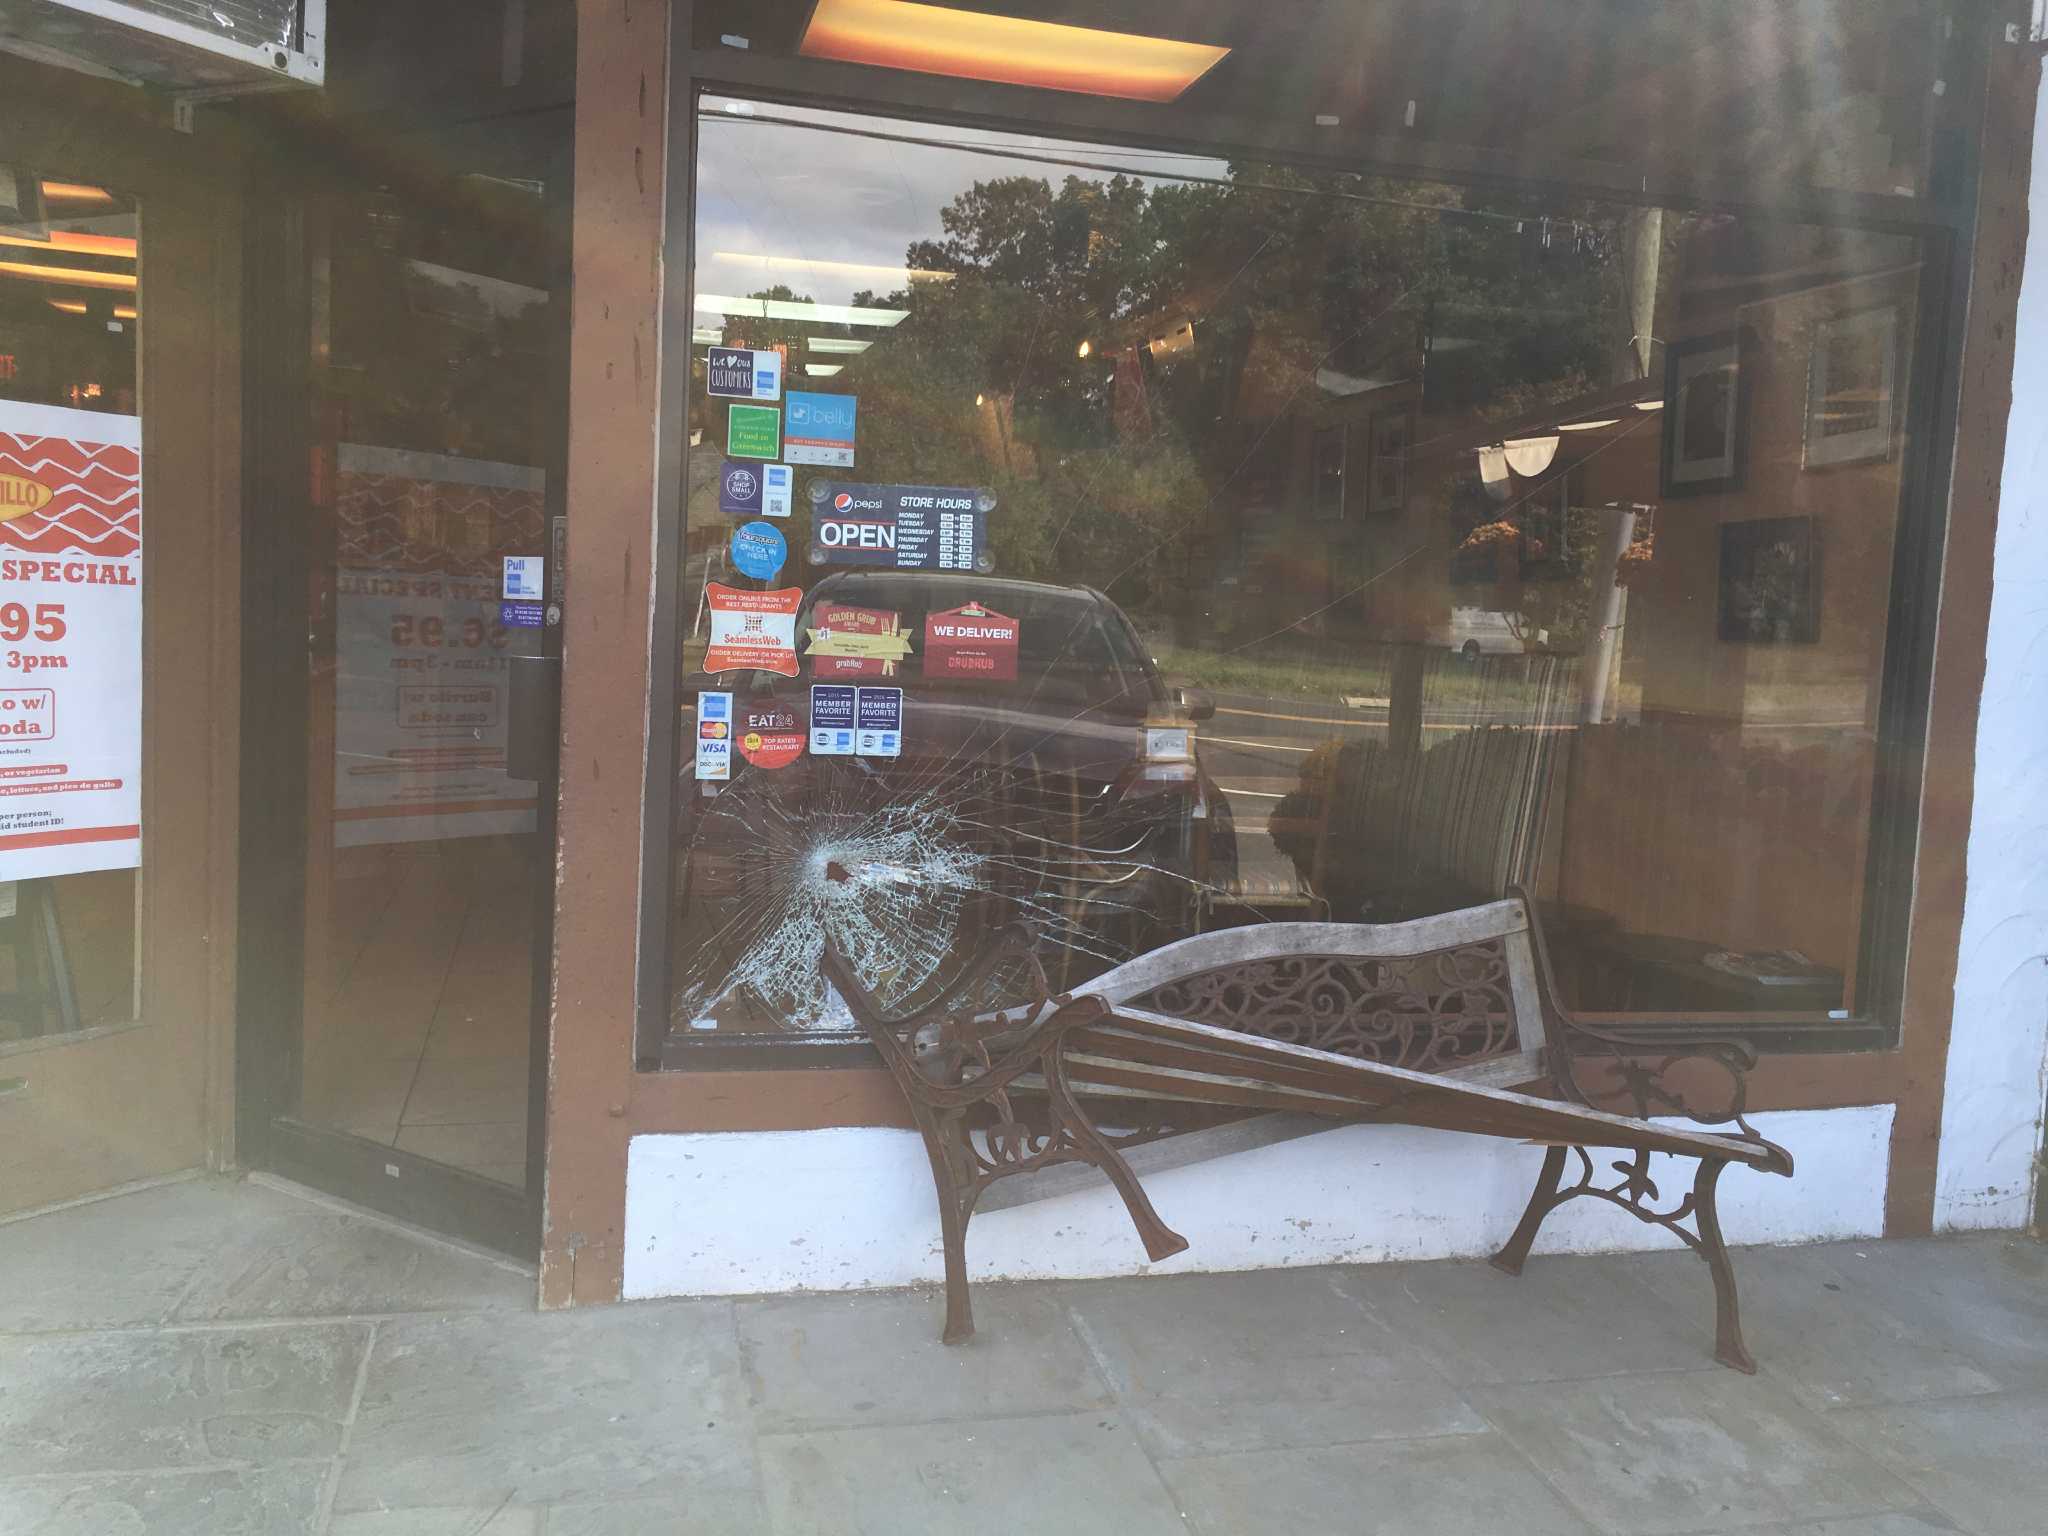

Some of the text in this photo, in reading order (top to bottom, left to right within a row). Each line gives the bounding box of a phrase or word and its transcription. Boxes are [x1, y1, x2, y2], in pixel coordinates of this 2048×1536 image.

[711, 370, 751, 389] CUSTOMERS
[813, 407, 853, 429] belly
[854, 499, 882, 509] pepsi
[900, 496, 972, 509] STORE HOURS
[820, 522, 896, 548] OPEN
[507, 559, 525, 571] Pull
[2, 560, 136, 586] SPECIAL
[934, 625, 1013, 639] WE DELIVER!
[7, 651, 68, 673] 3pm
[815, 707, 851, 715] FAVORITE
[861, 709, 896, 717] FAVORITE
[749, 714, 794, 727] EAT24
[703, 743, 726, 753] VISA
[13, 820, 49, 829] student
